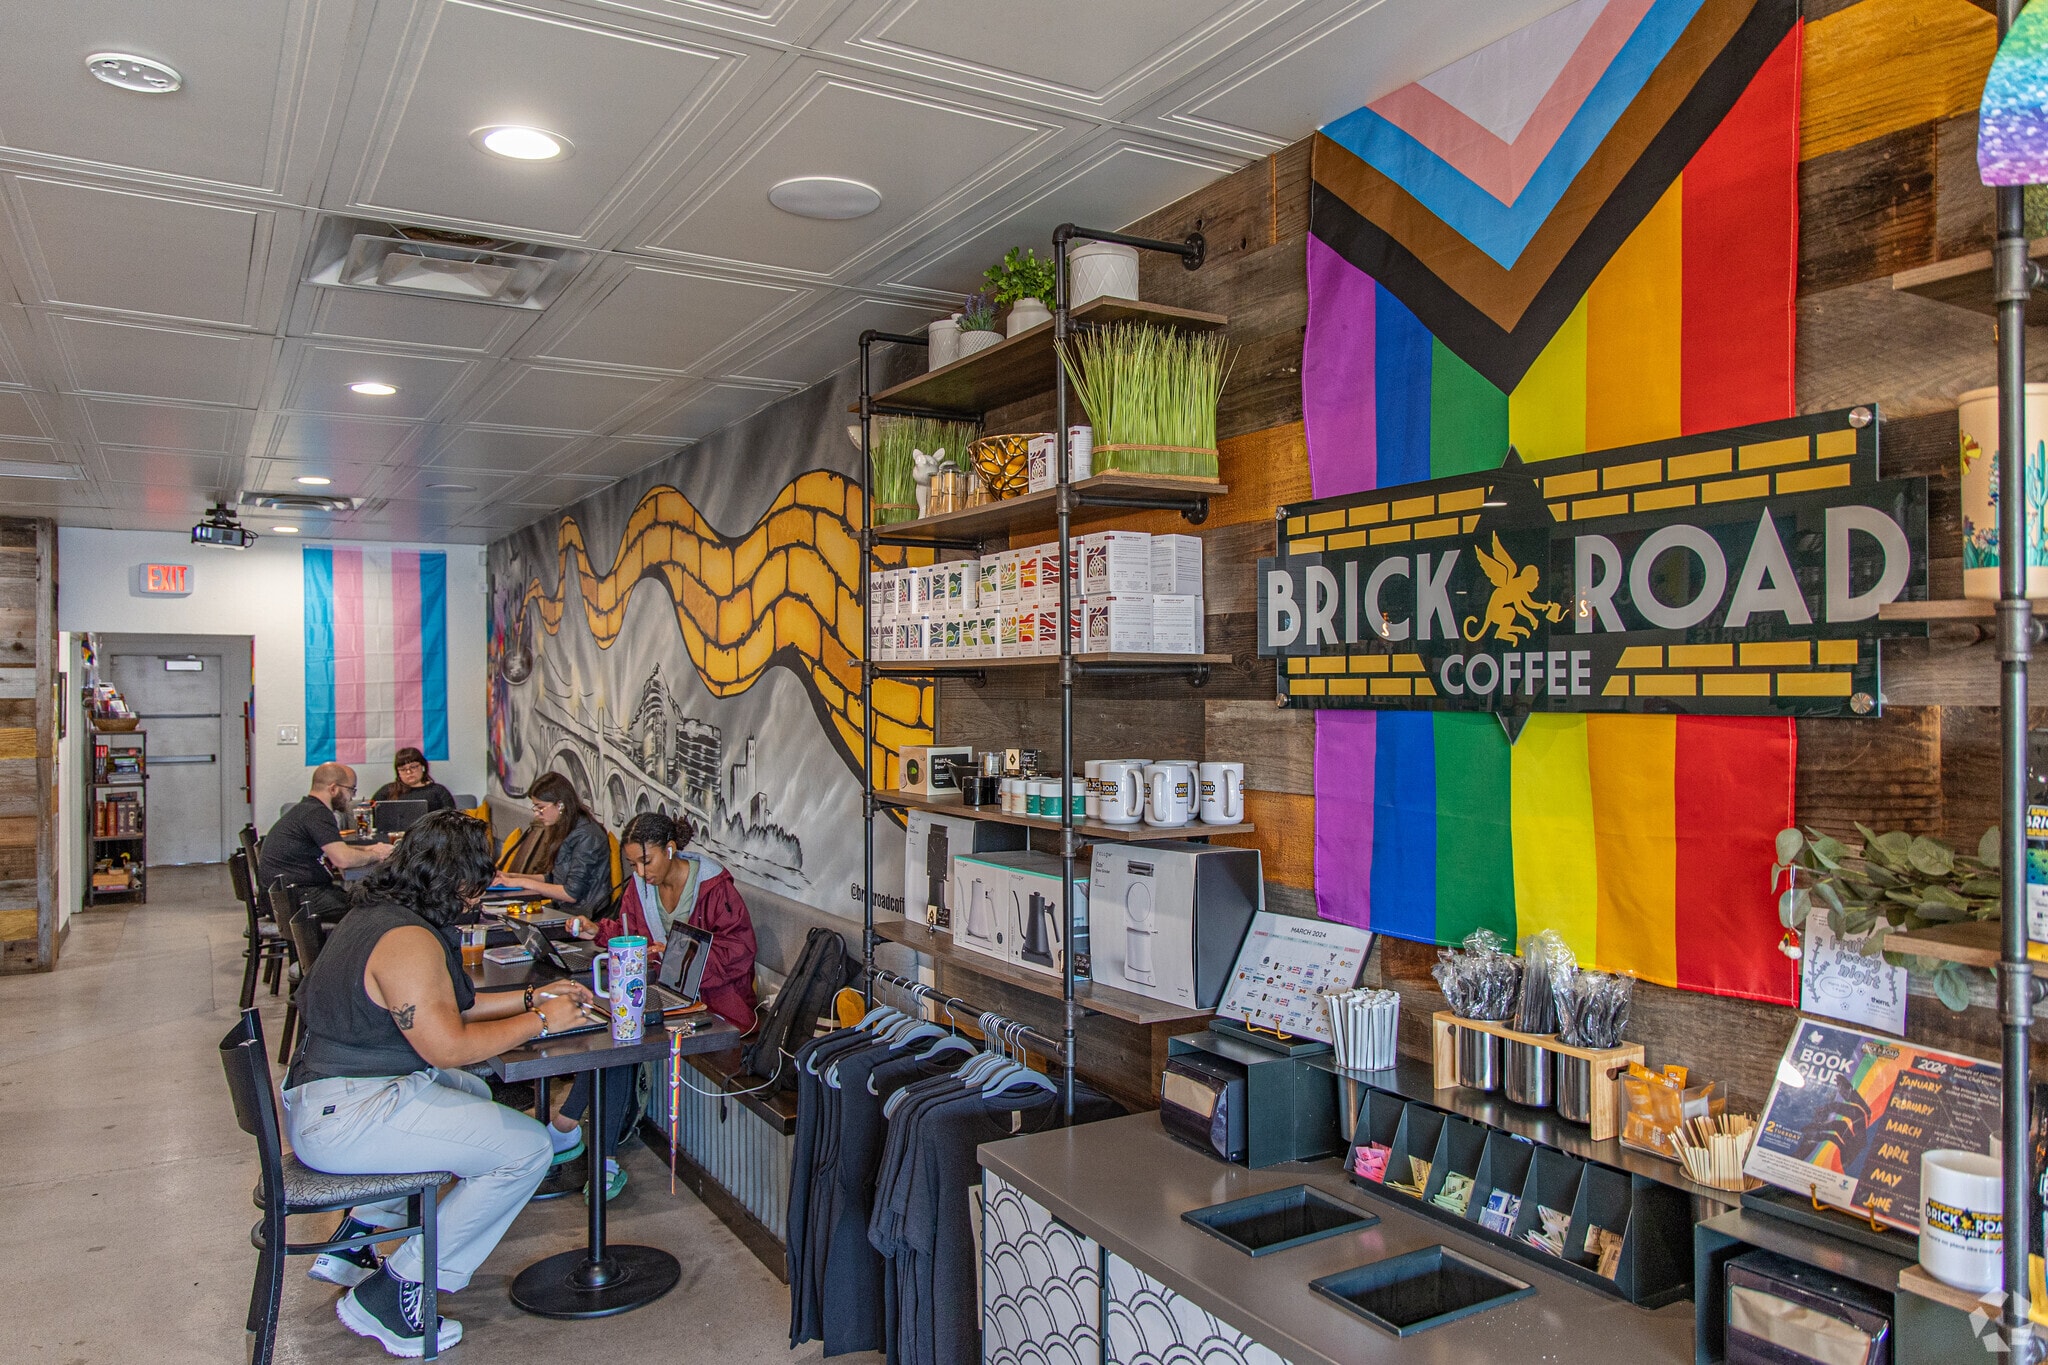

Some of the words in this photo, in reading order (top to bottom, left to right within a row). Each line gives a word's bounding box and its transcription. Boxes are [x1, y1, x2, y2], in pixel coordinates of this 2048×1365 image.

[147, 565, 187, 592] EXIT
[1267, 548, 1461, 647] BRICK
[1574, 506, 1911, 633] ROAD
[1440, 650, 1592, 696] COFFEE
[851, 882, 905, 914] @brroadcoff
[1291, 926, 1312, 936] MARCH
[1312, 929, 1327, 939] 2024
[1799, 1048, 1854, 1074] BOOK
[1918, 1060, 1948, 1074] 2024
[1774, 1128, 1801, 1140] TUESDAY
[1885, 1119, 1922, 1138] MARCH
[1877, 1143, 1910, 1164] APRIL
[1870, 1168, 1903, 1188] MAY
[1862, 1191, 1893, 1213] JUNE
[1926, 1206, 1959, 1227] BRICK
[1975, 1219, 2003, 1234] ROA
[1953, 1228, 1980, 1238] COFFEE
